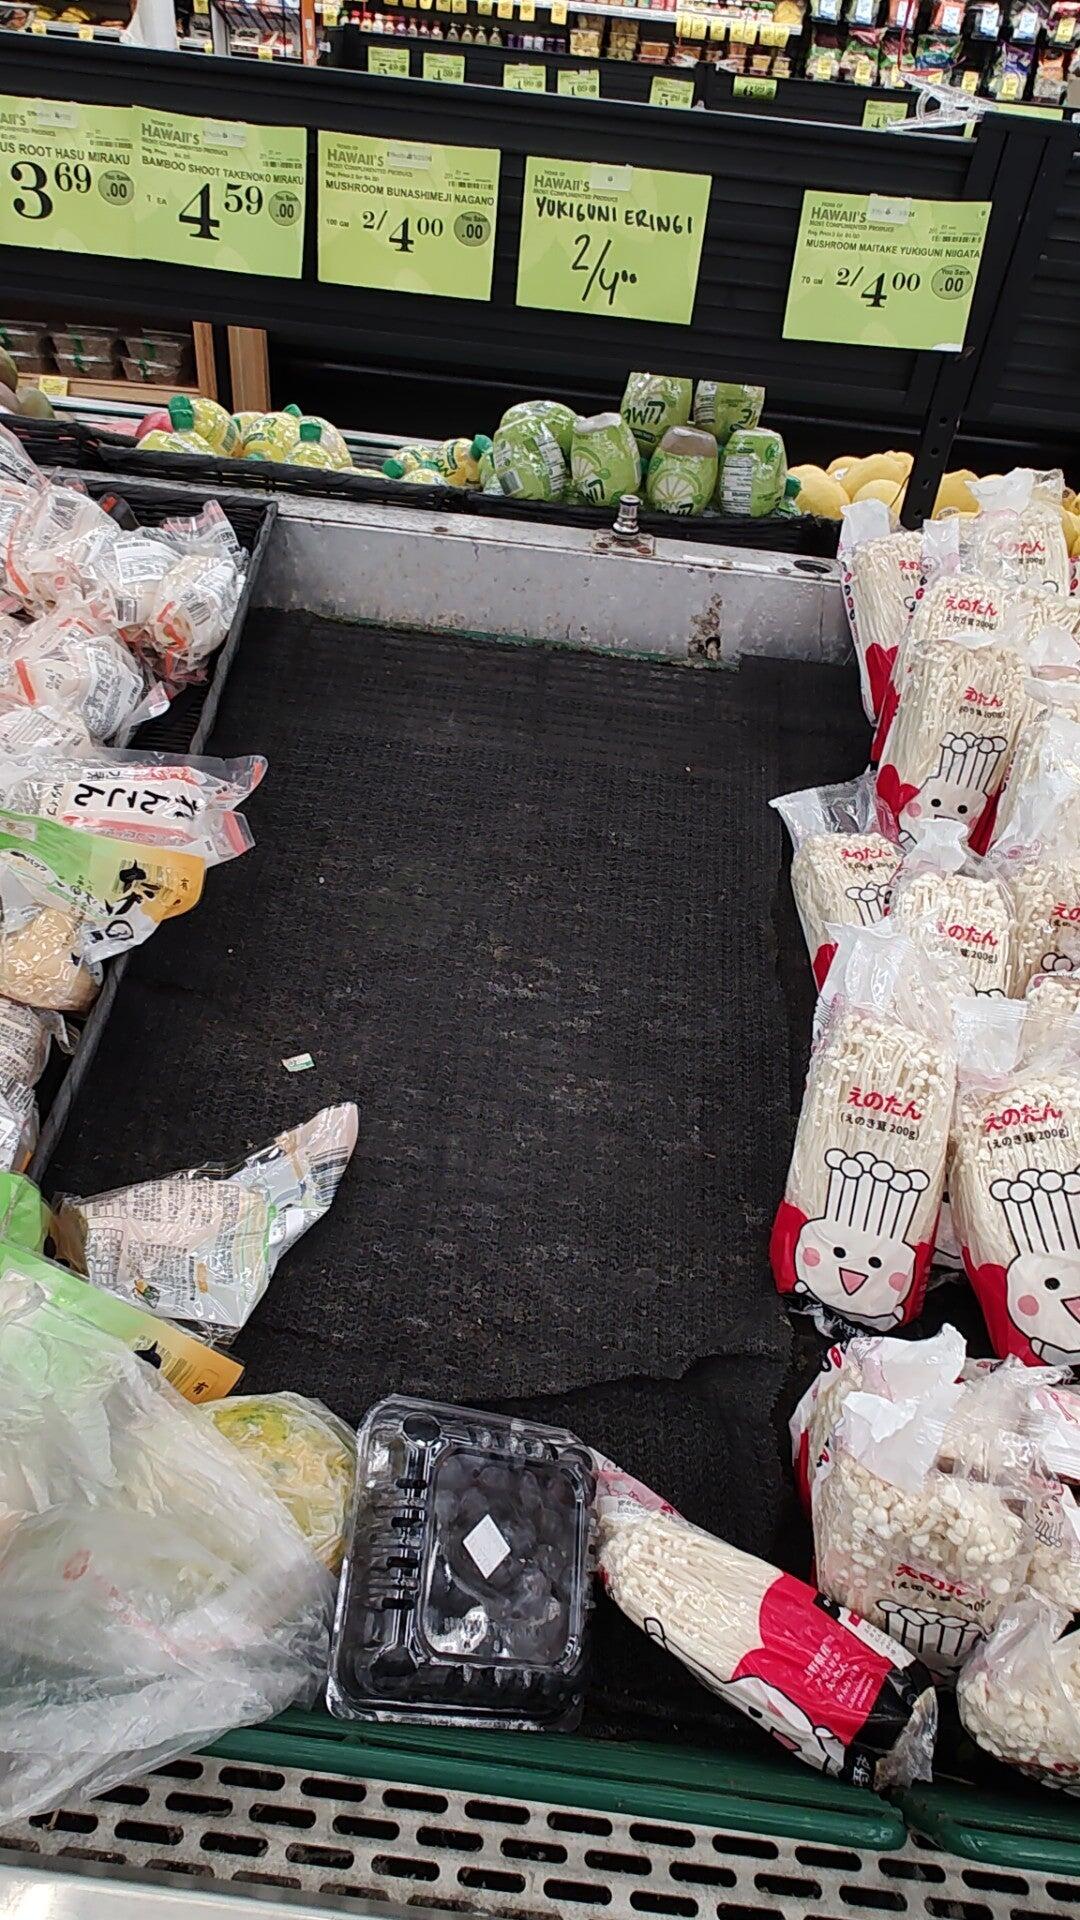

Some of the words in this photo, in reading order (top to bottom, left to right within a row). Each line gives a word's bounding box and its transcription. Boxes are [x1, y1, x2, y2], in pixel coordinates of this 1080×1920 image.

[141, 123, 199, 145] HAWAII'S
[19, 143, 52, 158] ROOT
[55, 148, 85, 160] HASU
[88, 151, 130, 165] MIRAKU
[327, 148, 384, 167] HAWAII'S
[142, 155, 185, 171] BAMBOO
[189, 164, 220, 177] SHOOT
[223, 168, 271, 183] TAKENOKO
[273, 175, 304, 186] MIRAKU
[325, 179, 384, 195] MUSHROOM
[387, 187, 452, 203] BUNASHIMEJI
[454, 193, 495, 207] NAGANO
[534, 174, 590, 192] HAWAII'S
[536, 196, 617, 222] YUKIGUNI
[625, 209, 693, 234] ERINGI
[811, 207, 867, 223] HAWAII'S
[806, 239, 857, 251] MUSHROOM
[859, 243, 898, 254] MAITAKE
[900, 246, 943, 258] YUKIGUNI
[945, 249, 980, 258] NIIGATA
[801, 275, 811, 284] 70
[946, 595, 997, 616] えのたん
[841, 847, 891, 861] えのたん
[846, 1087, 922, 1120] えのたん
[984, 1102, 1063, 1132] えのたん
